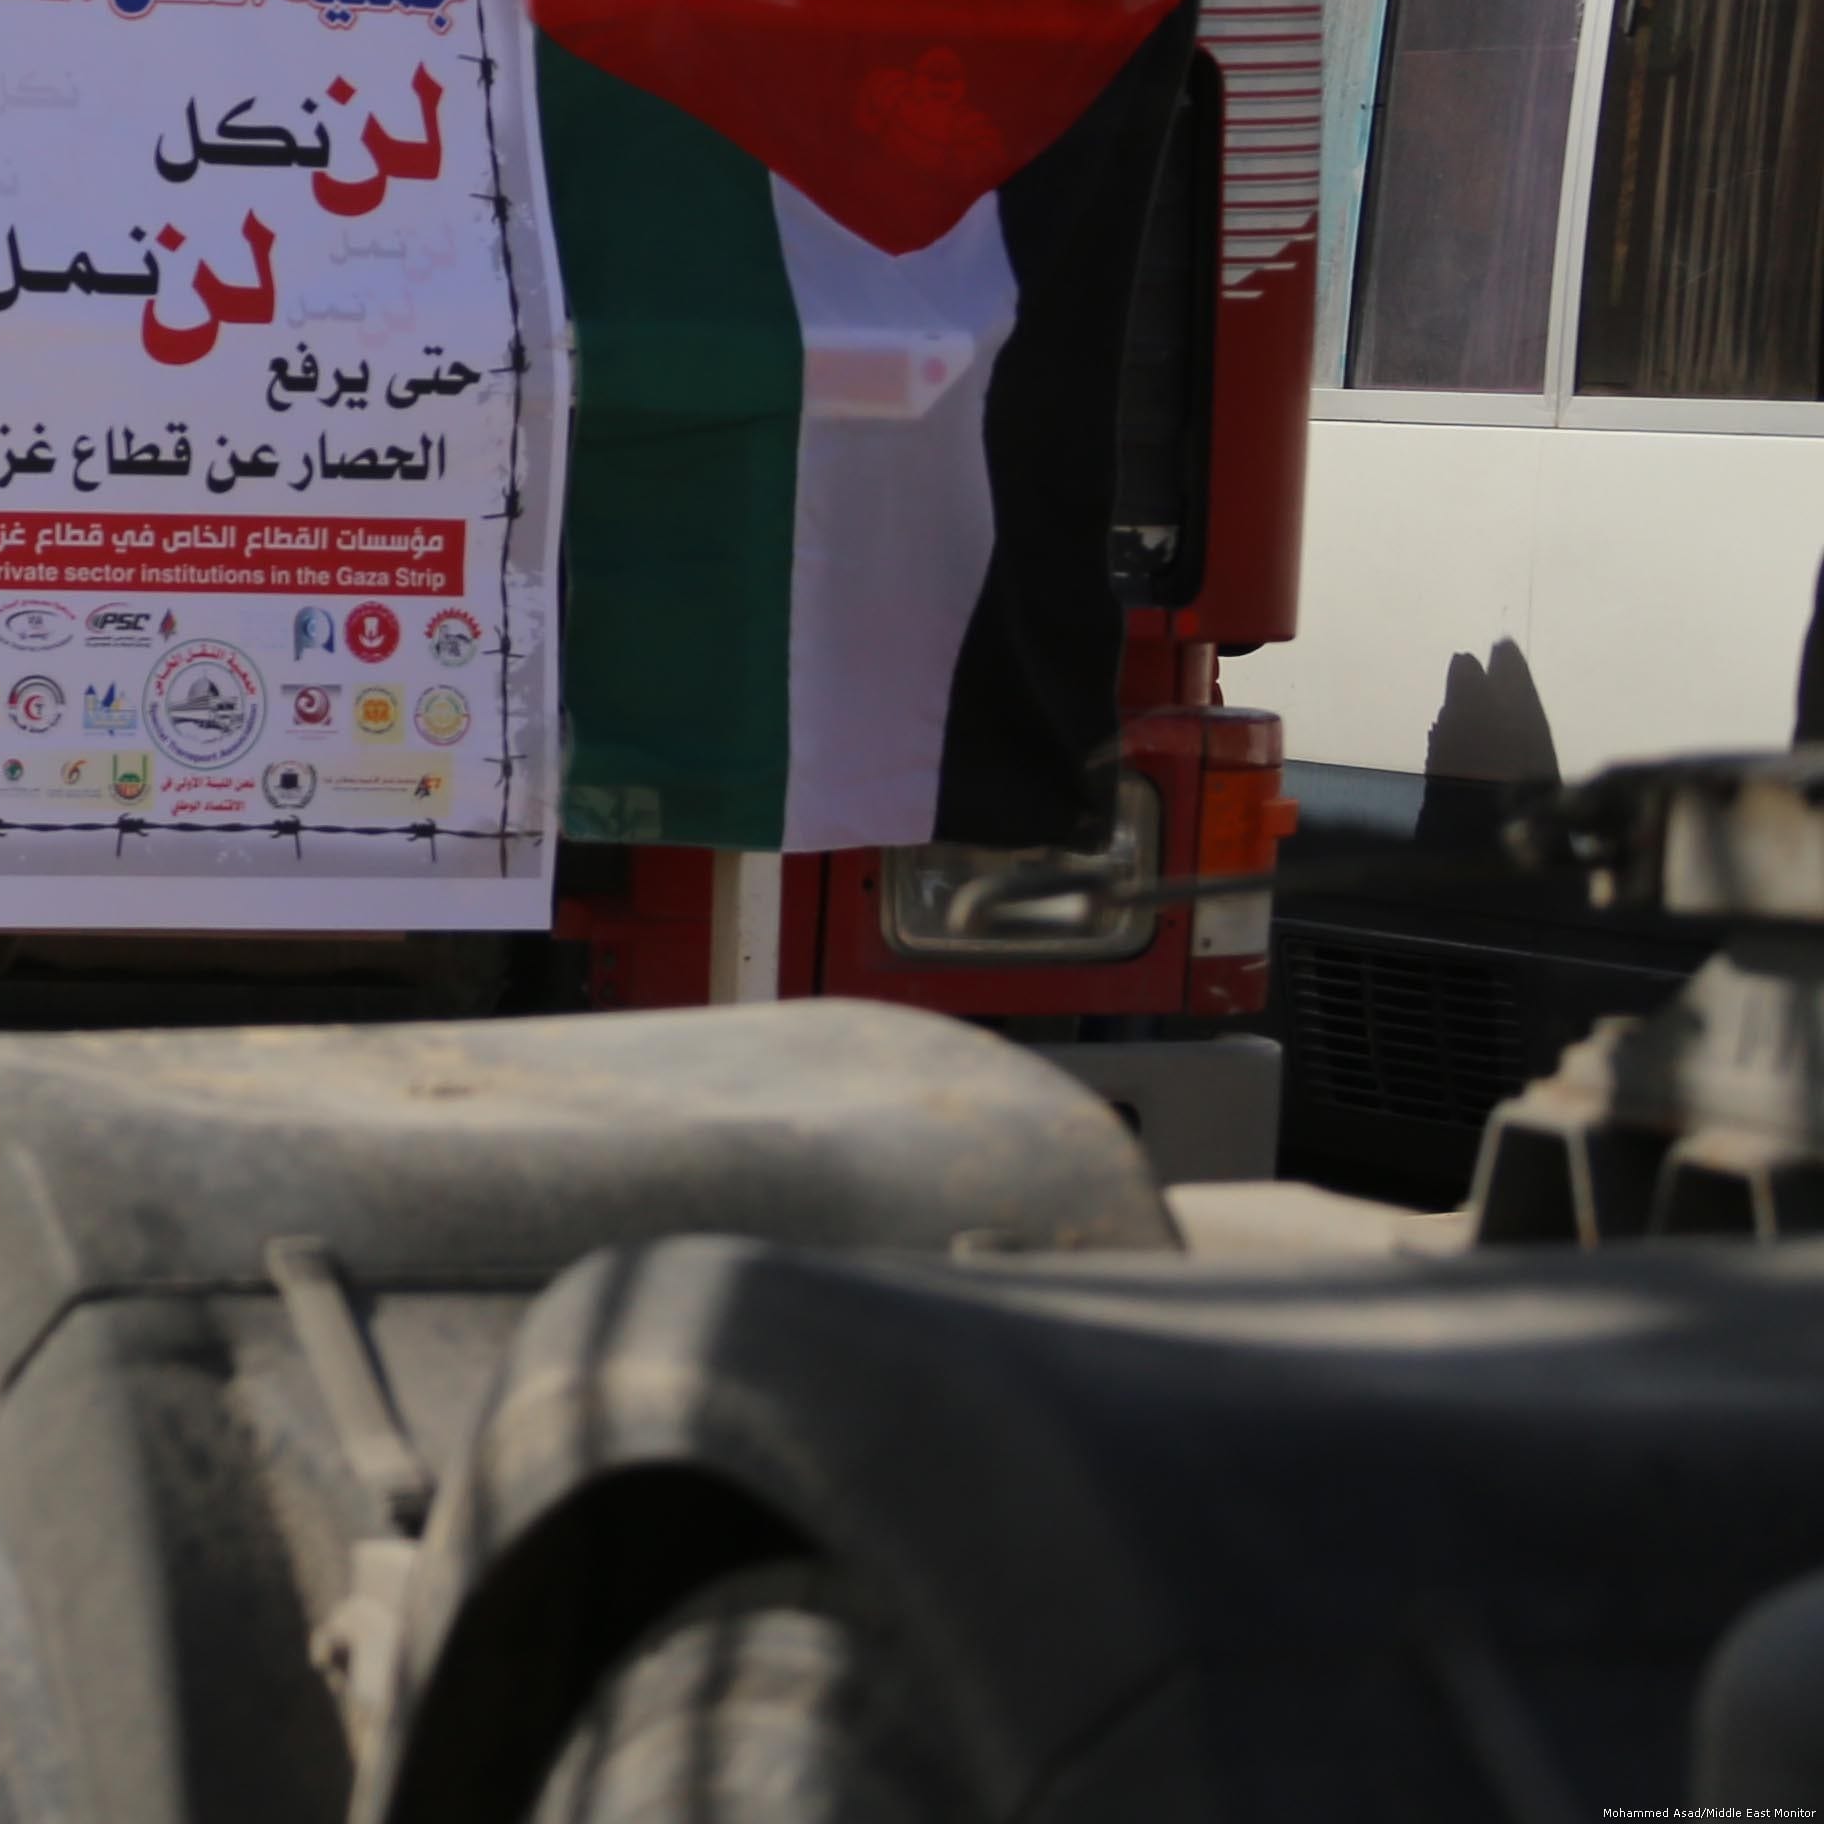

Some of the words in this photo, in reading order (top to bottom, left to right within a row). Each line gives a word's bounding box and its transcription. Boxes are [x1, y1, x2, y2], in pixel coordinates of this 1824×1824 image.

[155, 93, 329, 183] نكل
[312, 62, 444, 215] لن
[141, 209, 276, 364] لن
[266, 343, 370, 410] يرفع
[386, 347, 481, 407] حتى
[72, 422, 193, 493] قطاع
[207, 433, 279, 493] عن
[293, 433, 446, 491] الحصار
[34, 522, 105, 555] قطاع
[111, 524, 155, 553] في
[162, 524, 237, 553] الخاص
[244, 526, 329, 558] القطاع
[336, 527, 444, 560] مؤسسات
[64, 564, 136, 583] sector
[141, 564, 265, 586] institutions
[270, 565, 292, 586] in
[296, 566, 331, 587] the
[336, 567, 390, 587] Gaza
[395, 567, 447, 591] Strip
